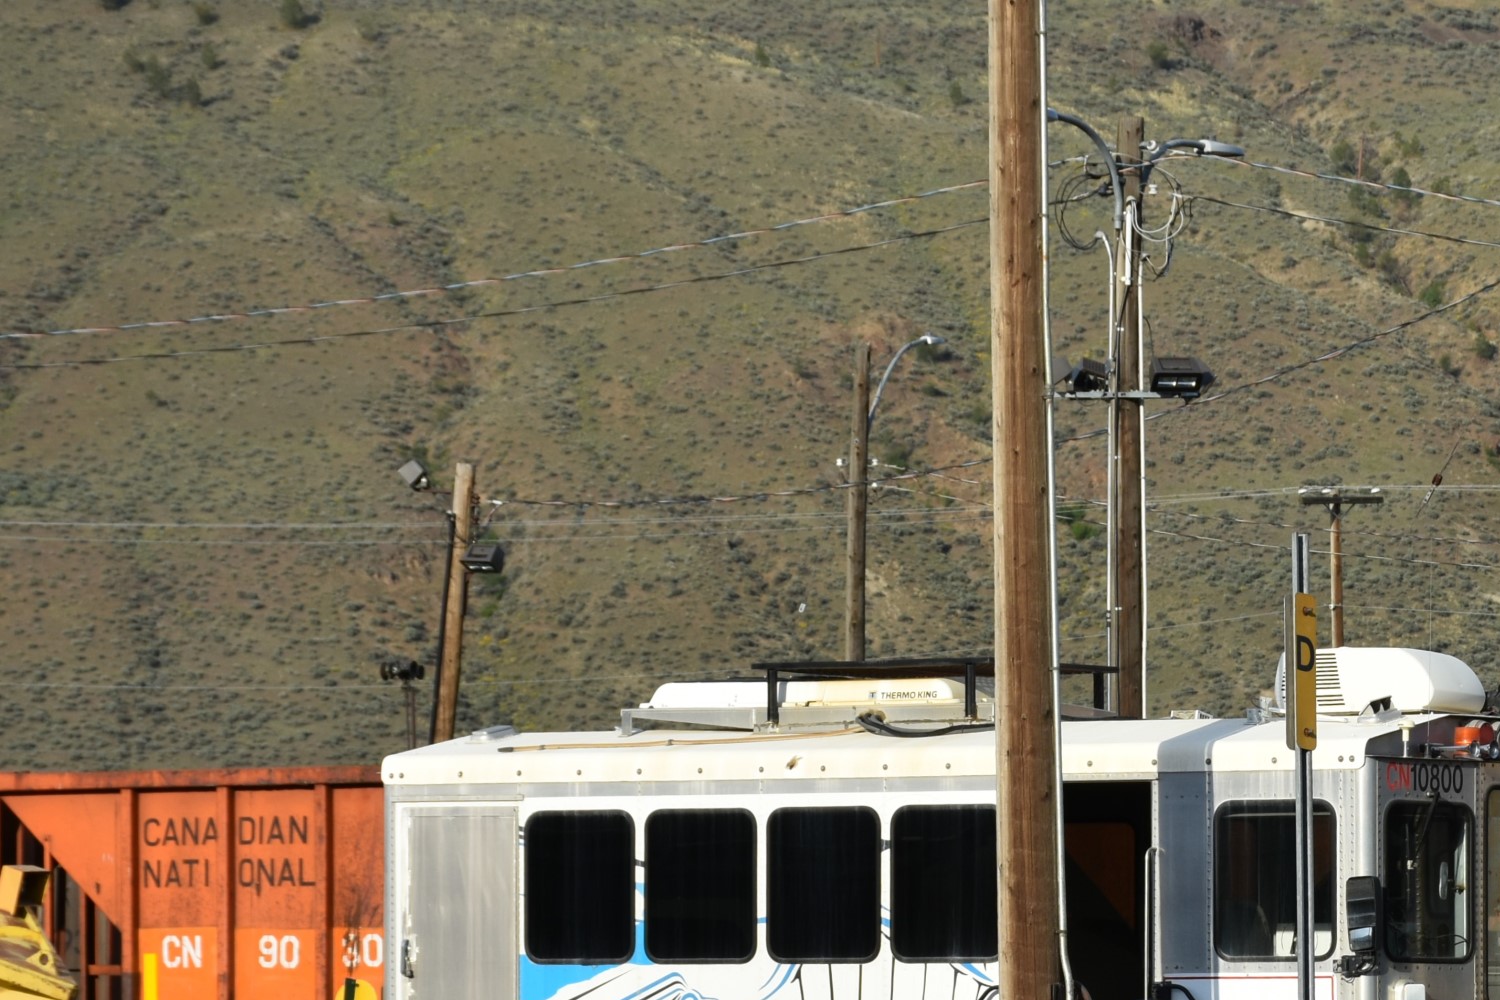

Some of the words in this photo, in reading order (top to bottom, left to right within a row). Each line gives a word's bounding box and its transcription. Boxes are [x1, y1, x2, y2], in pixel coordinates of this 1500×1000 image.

[1297, 635, 1315, 672] D
[881, 691, 917, 700] THERMO
[917, 690, 938, 699] KING
[161, 935, 203, 969] CN
